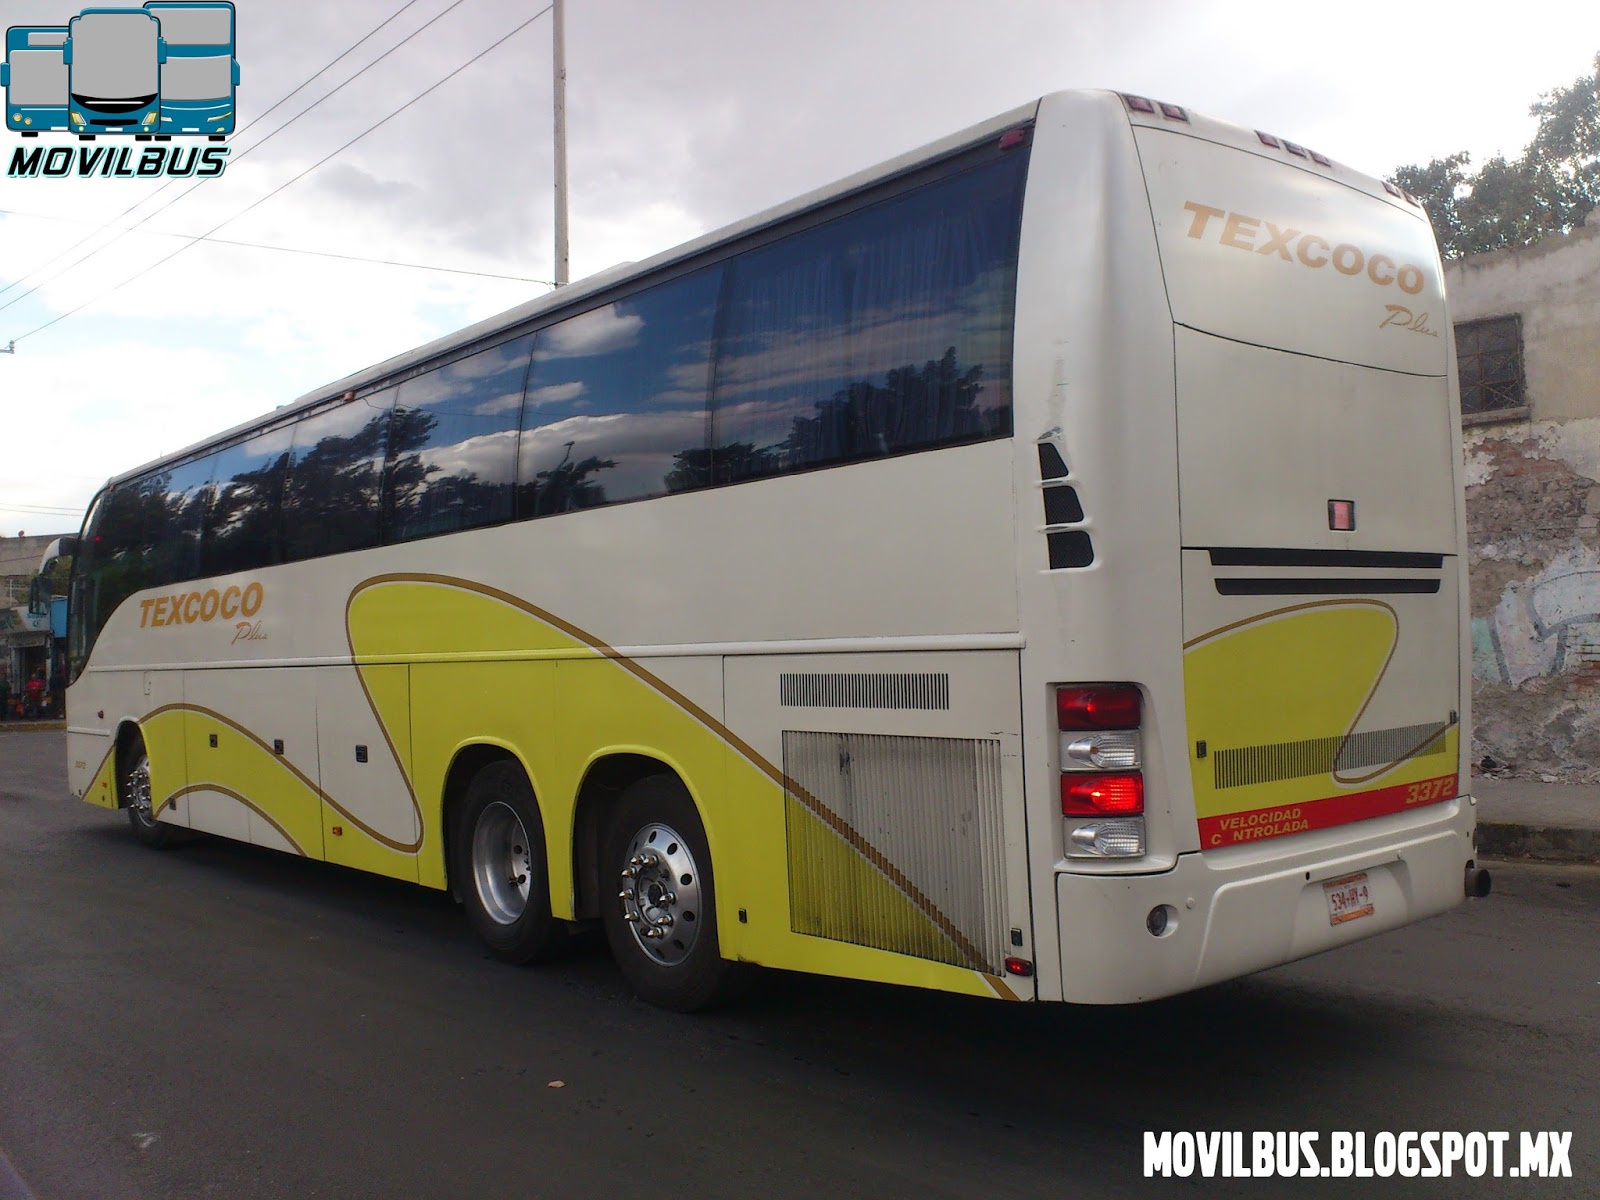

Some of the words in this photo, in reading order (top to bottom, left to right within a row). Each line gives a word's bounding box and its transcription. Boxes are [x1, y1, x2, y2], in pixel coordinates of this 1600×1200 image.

[1184, 200, 1424, 295] TEXCOCO
[1379, 303, 1438, 337] Plus
[139, 581, 264, 628] TEXCOCO
[231, 620, 268, 645] Plus
[1406, 777, 1454, 804] 3372
[1211, 819, 1309, 845] CNTROLADA
[1220, 808, 1301, 831] VELOCIDAD
